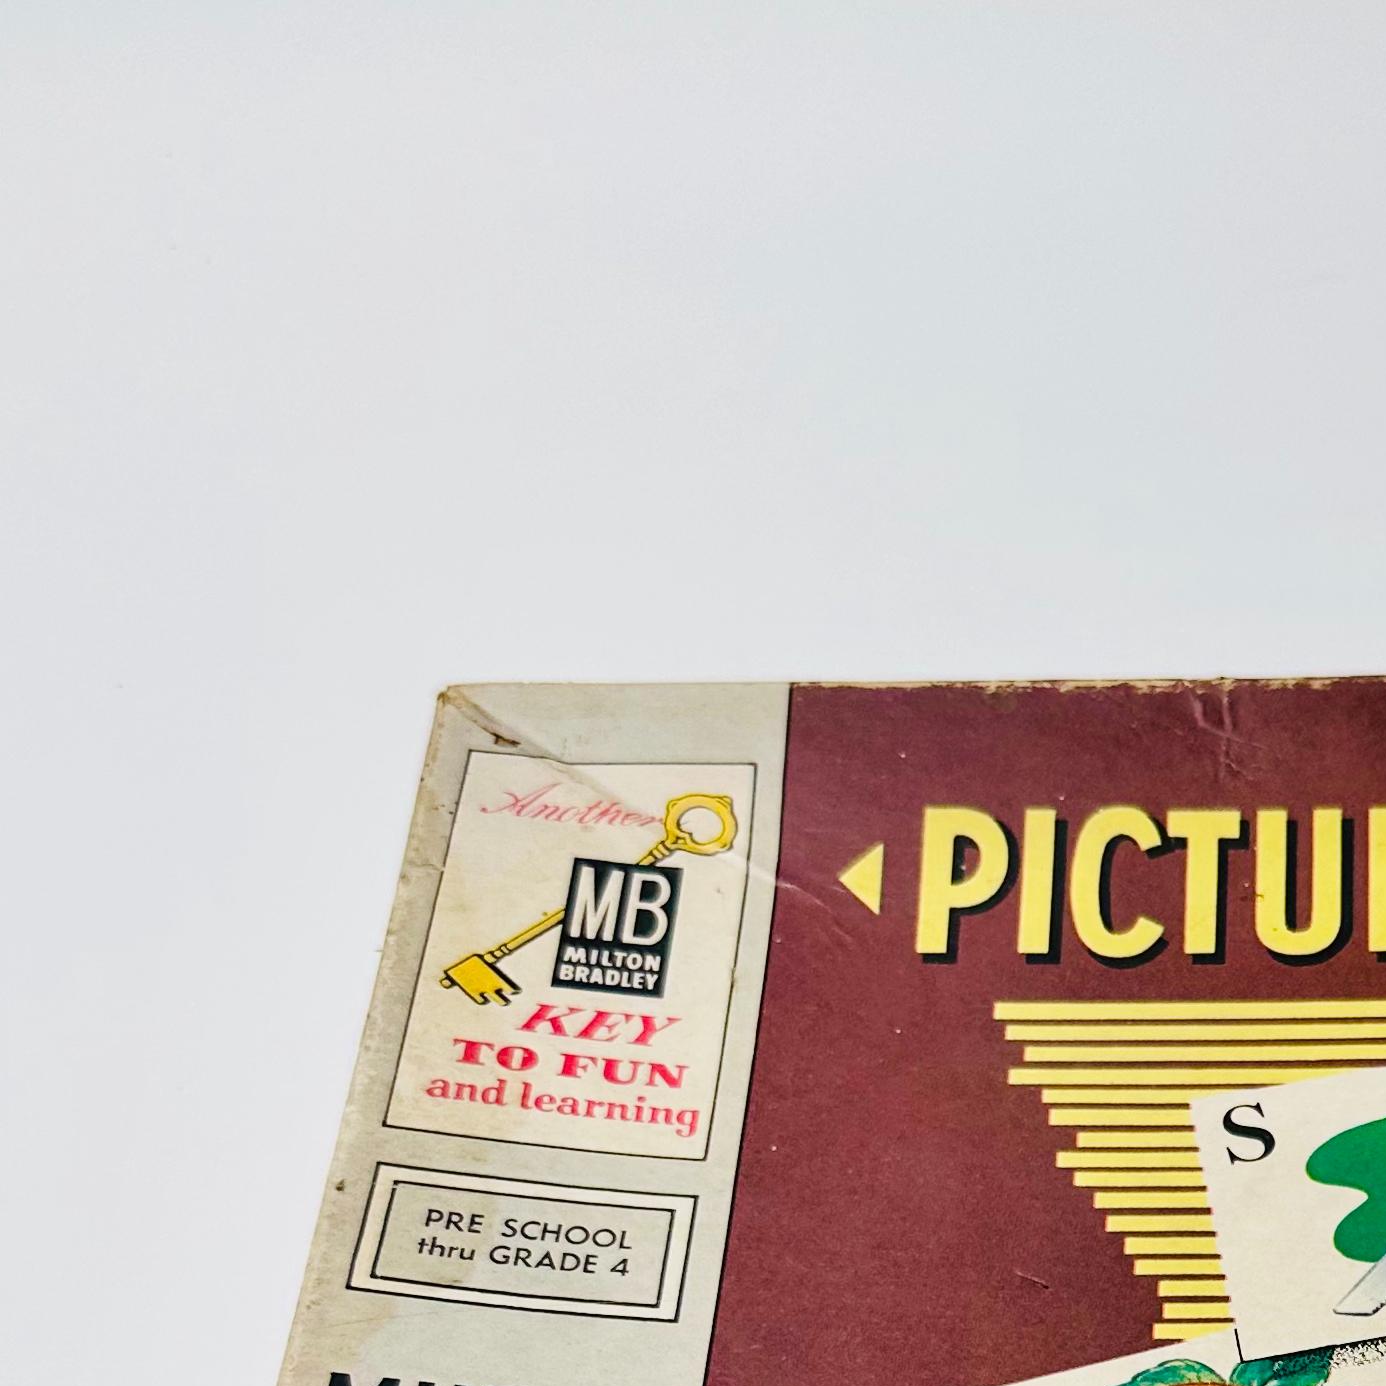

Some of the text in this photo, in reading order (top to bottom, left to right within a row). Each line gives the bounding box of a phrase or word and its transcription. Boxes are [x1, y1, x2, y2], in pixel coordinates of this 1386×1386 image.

[480, 782, 664, 827] Another
[567, 866, 669, 946] MB
[559, 964, 660, 991] BRADLEY
[562, 945, 662, 972] MILTON
[519, 1002, 683, 1047] KEY
[452, 1038, 690, 1090] TO FUN
[425, 1076, 701, 1138] and learning
[1221, 1101, 1277, 1166] S
[424, 1208, 633, 1250] PRE SCHOOL
[417, 1237, 631, 1277] thru GRADE 4
